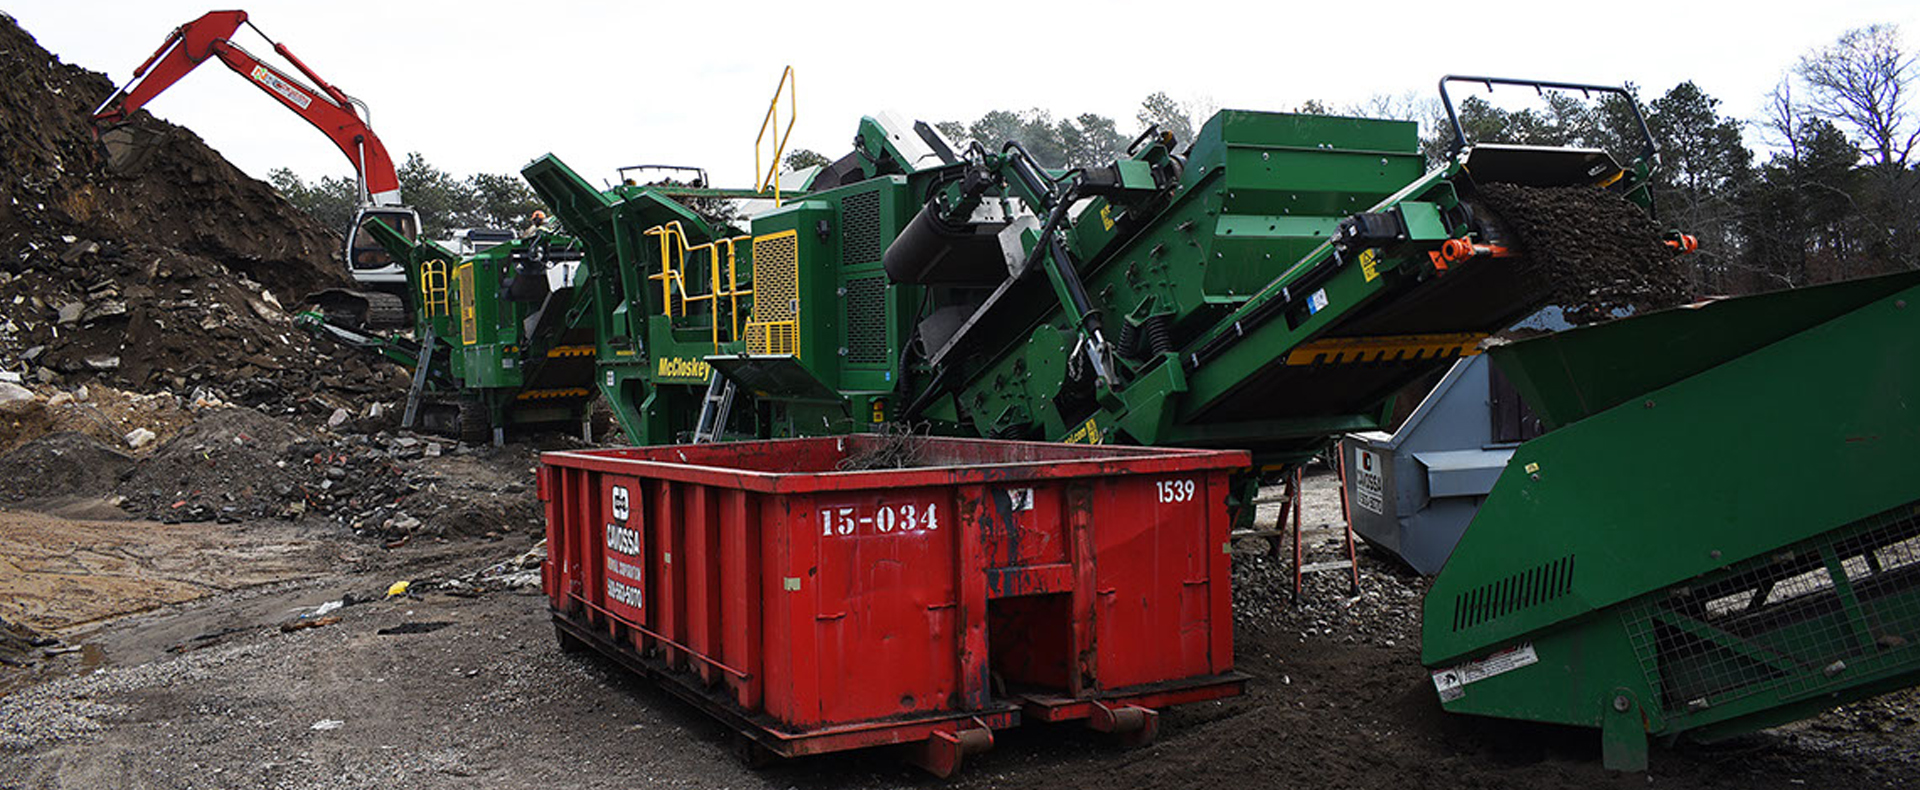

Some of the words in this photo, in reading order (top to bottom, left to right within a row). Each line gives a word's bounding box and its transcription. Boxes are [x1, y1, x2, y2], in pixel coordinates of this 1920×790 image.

[658, 357, 711, 381] McCloskey
[1156, 480, 1195, 503] 1539
[820, 503, 938, 536] 15-034
[606, 523, 640, 555] CAVOSSA
